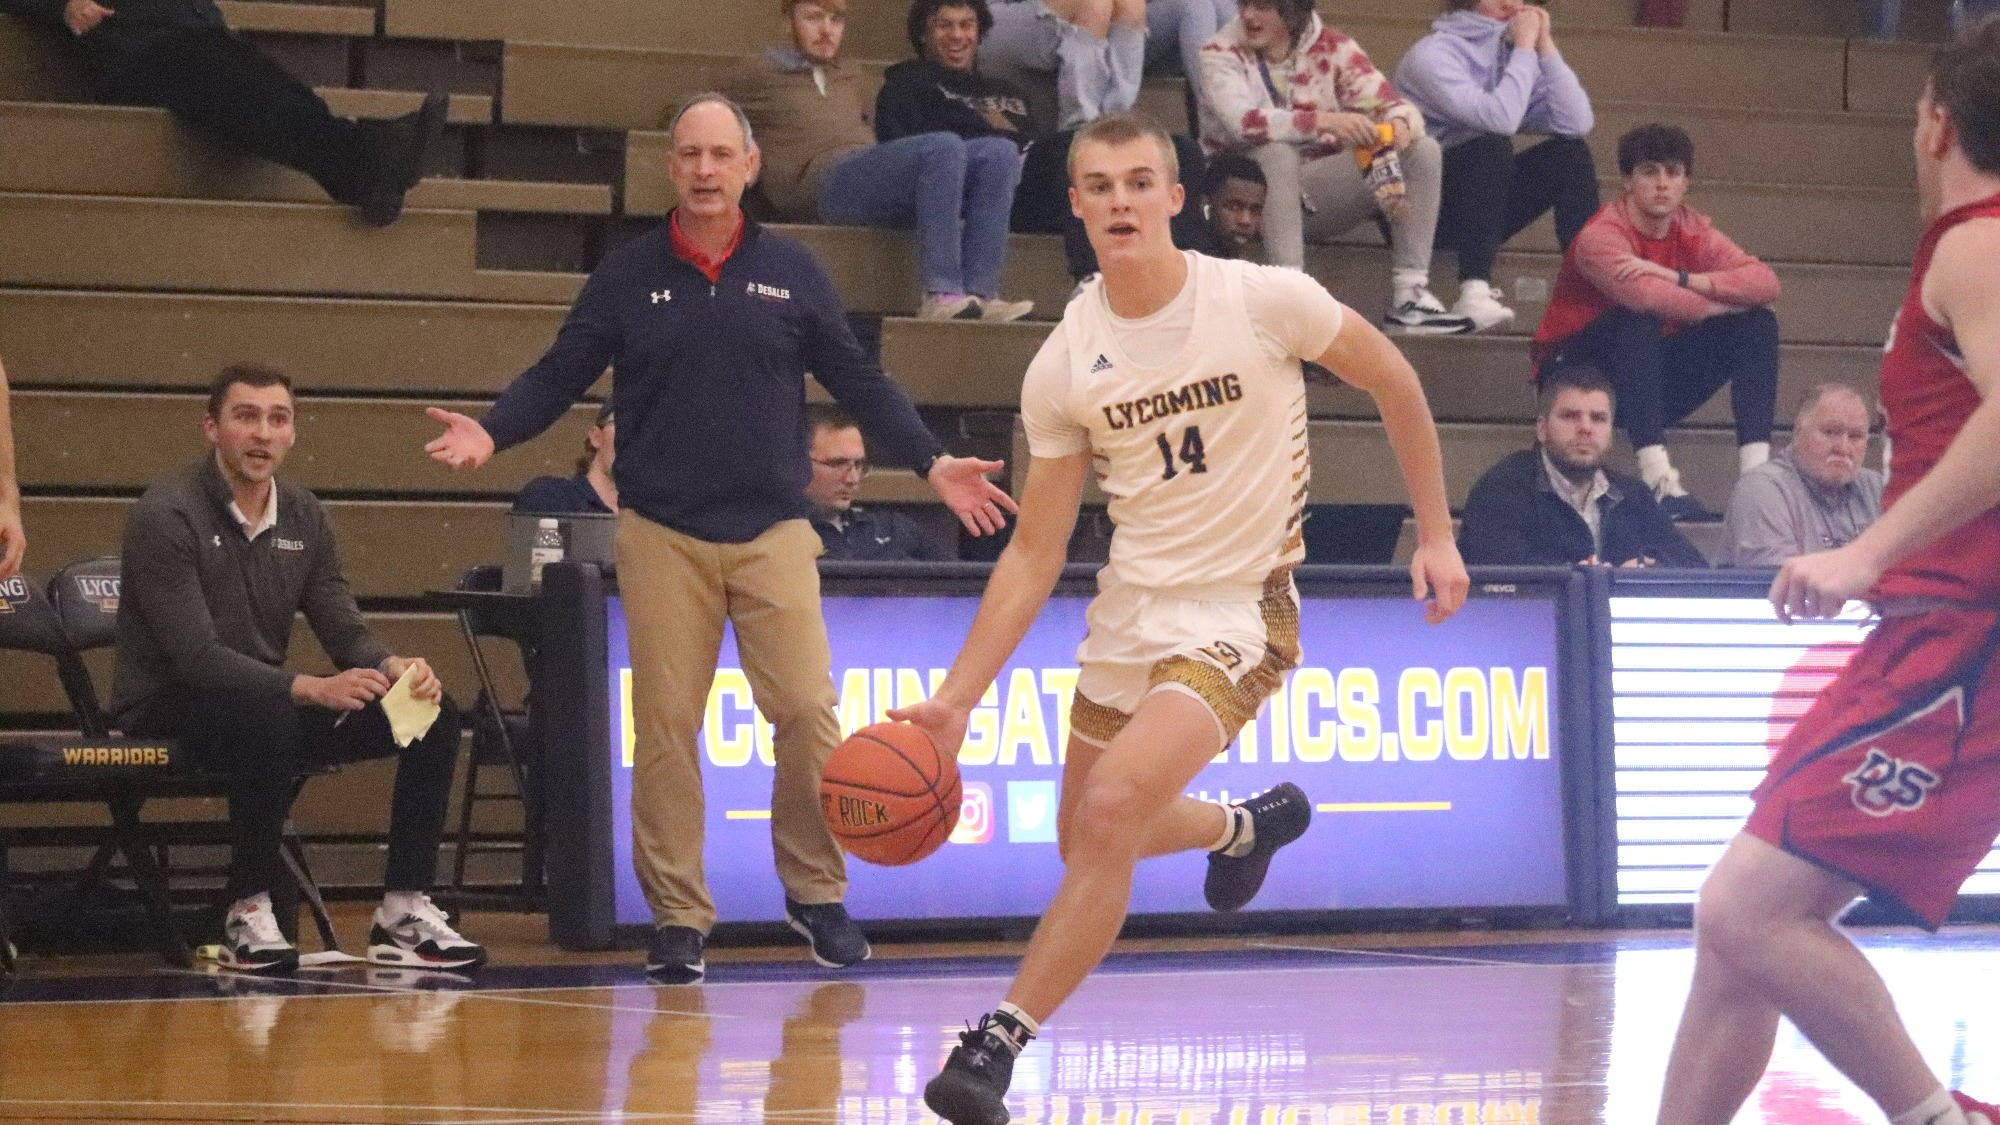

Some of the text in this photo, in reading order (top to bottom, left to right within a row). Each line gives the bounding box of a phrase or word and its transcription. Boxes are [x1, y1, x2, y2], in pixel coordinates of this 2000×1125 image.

[1102, 373, 1243, 430] LYCOMING
[1156, 425, 1208, 480] 14
[62, 747, 170, 765] WARRIORS
[839, 796, 889, 826] ROCK
